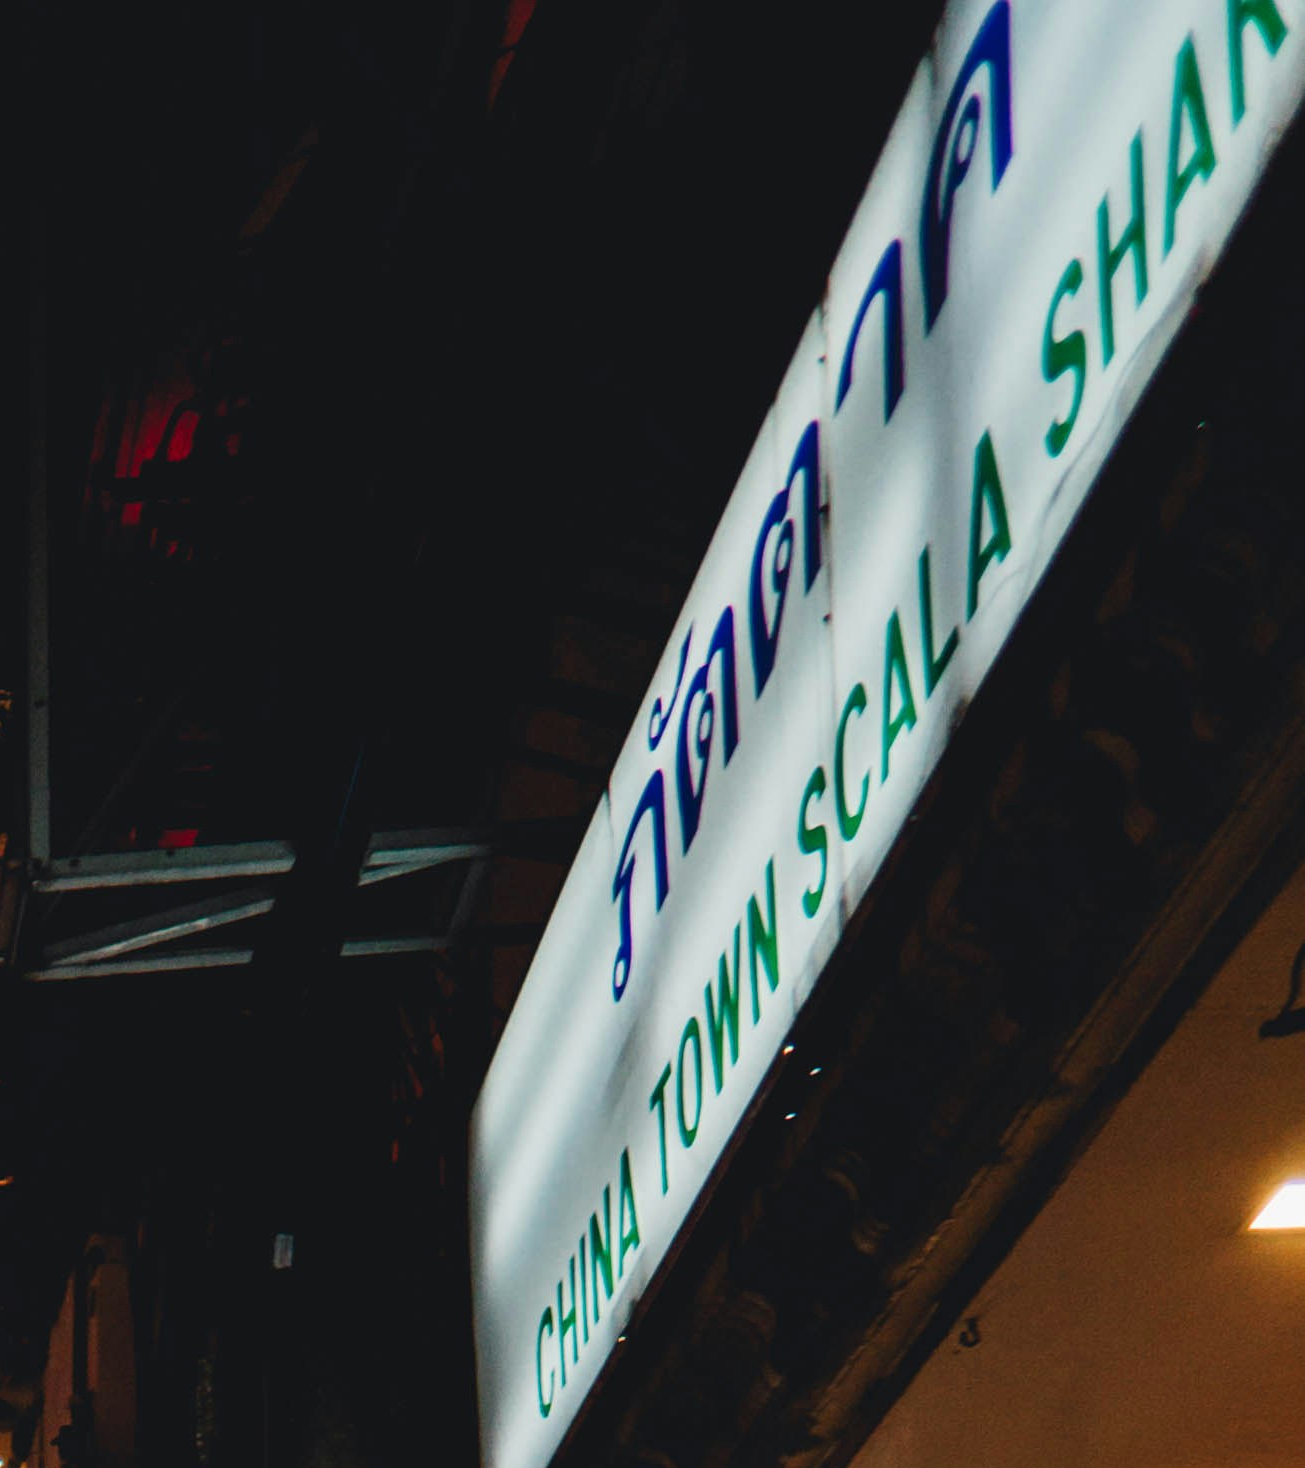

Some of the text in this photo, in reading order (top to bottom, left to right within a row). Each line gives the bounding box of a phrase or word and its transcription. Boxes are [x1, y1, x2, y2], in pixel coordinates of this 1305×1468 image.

[535, 1146, 641, 1419] CHINA
[649, 855, 780, 1196] TOWN
[798, 426, 1011, 918] SCALA
